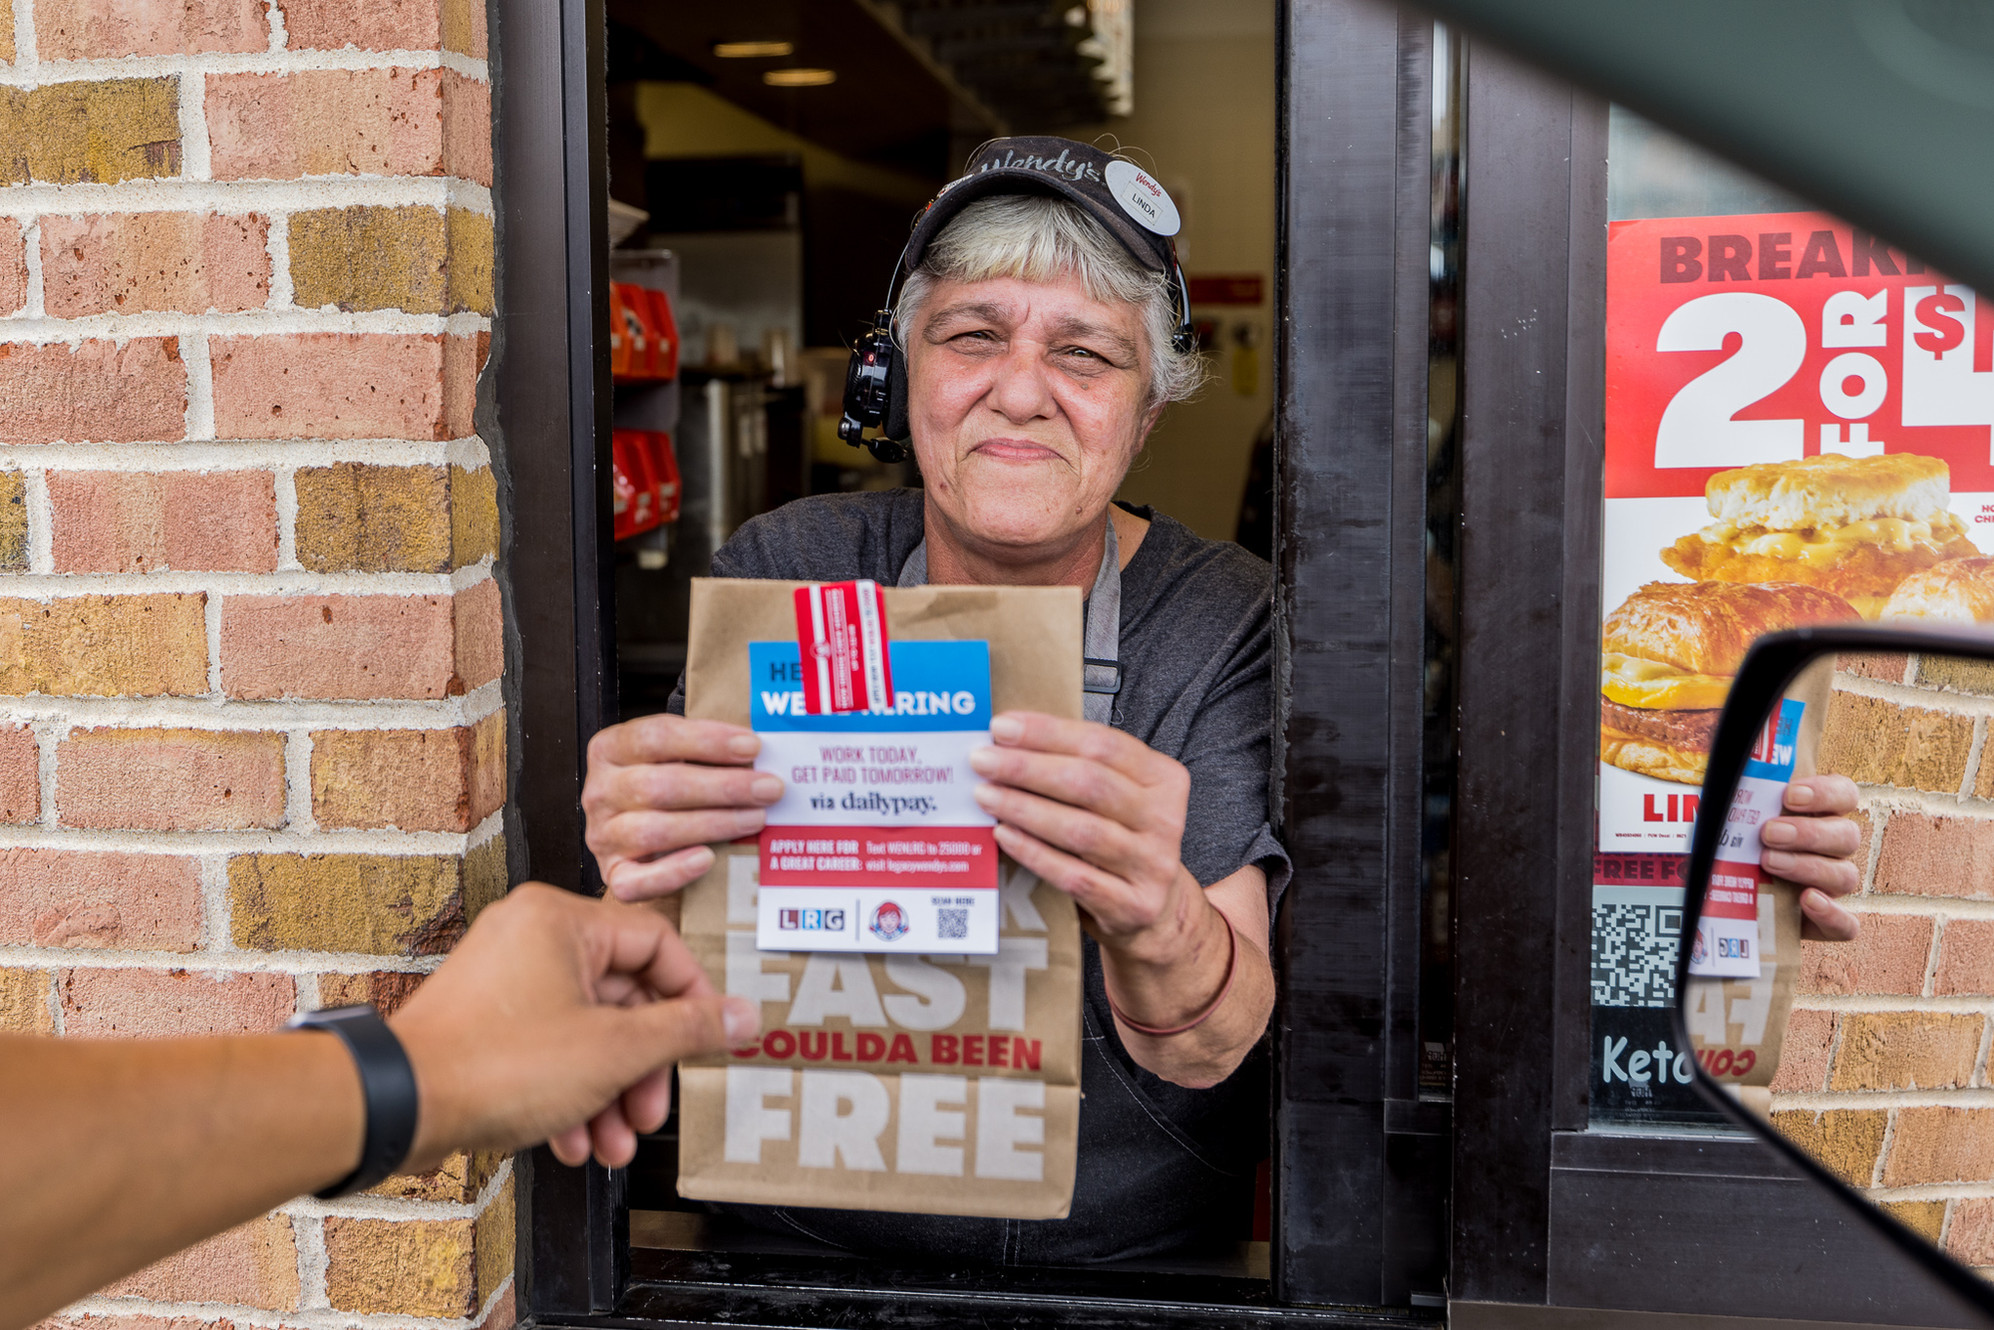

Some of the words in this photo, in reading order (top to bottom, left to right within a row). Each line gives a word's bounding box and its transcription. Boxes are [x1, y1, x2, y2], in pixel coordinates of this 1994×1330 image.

[1135, 172, 1162, 198] Wendy's
[1132, 193, 1156, 218] LINDA
[1659, 229, 1926, 285] BREAK
[1654, 292, 1808, 470] 2
[1819, 288, 1888, 457] FOR
[819, 746, 865, 764] WORK
[791, 766, 818, 784] GET
[822, 766, 857, 784] PAID
[861, 766, 954, 785] TOMORROW!
[810, 793, 835, 810] via
[841, 791, 938, 816] dailypay.
[770, 839, 805, 854] APPLY
[769, 856, 780, 871] A
[780, 856, 815, 871] GREAT
[779, 908, 844, 930] LRG
[725, 930, 1049, 1032] FAST
[931, 1034, 1042, 1071] BEEN
[724, 1065, 1045, 1182] FREE
